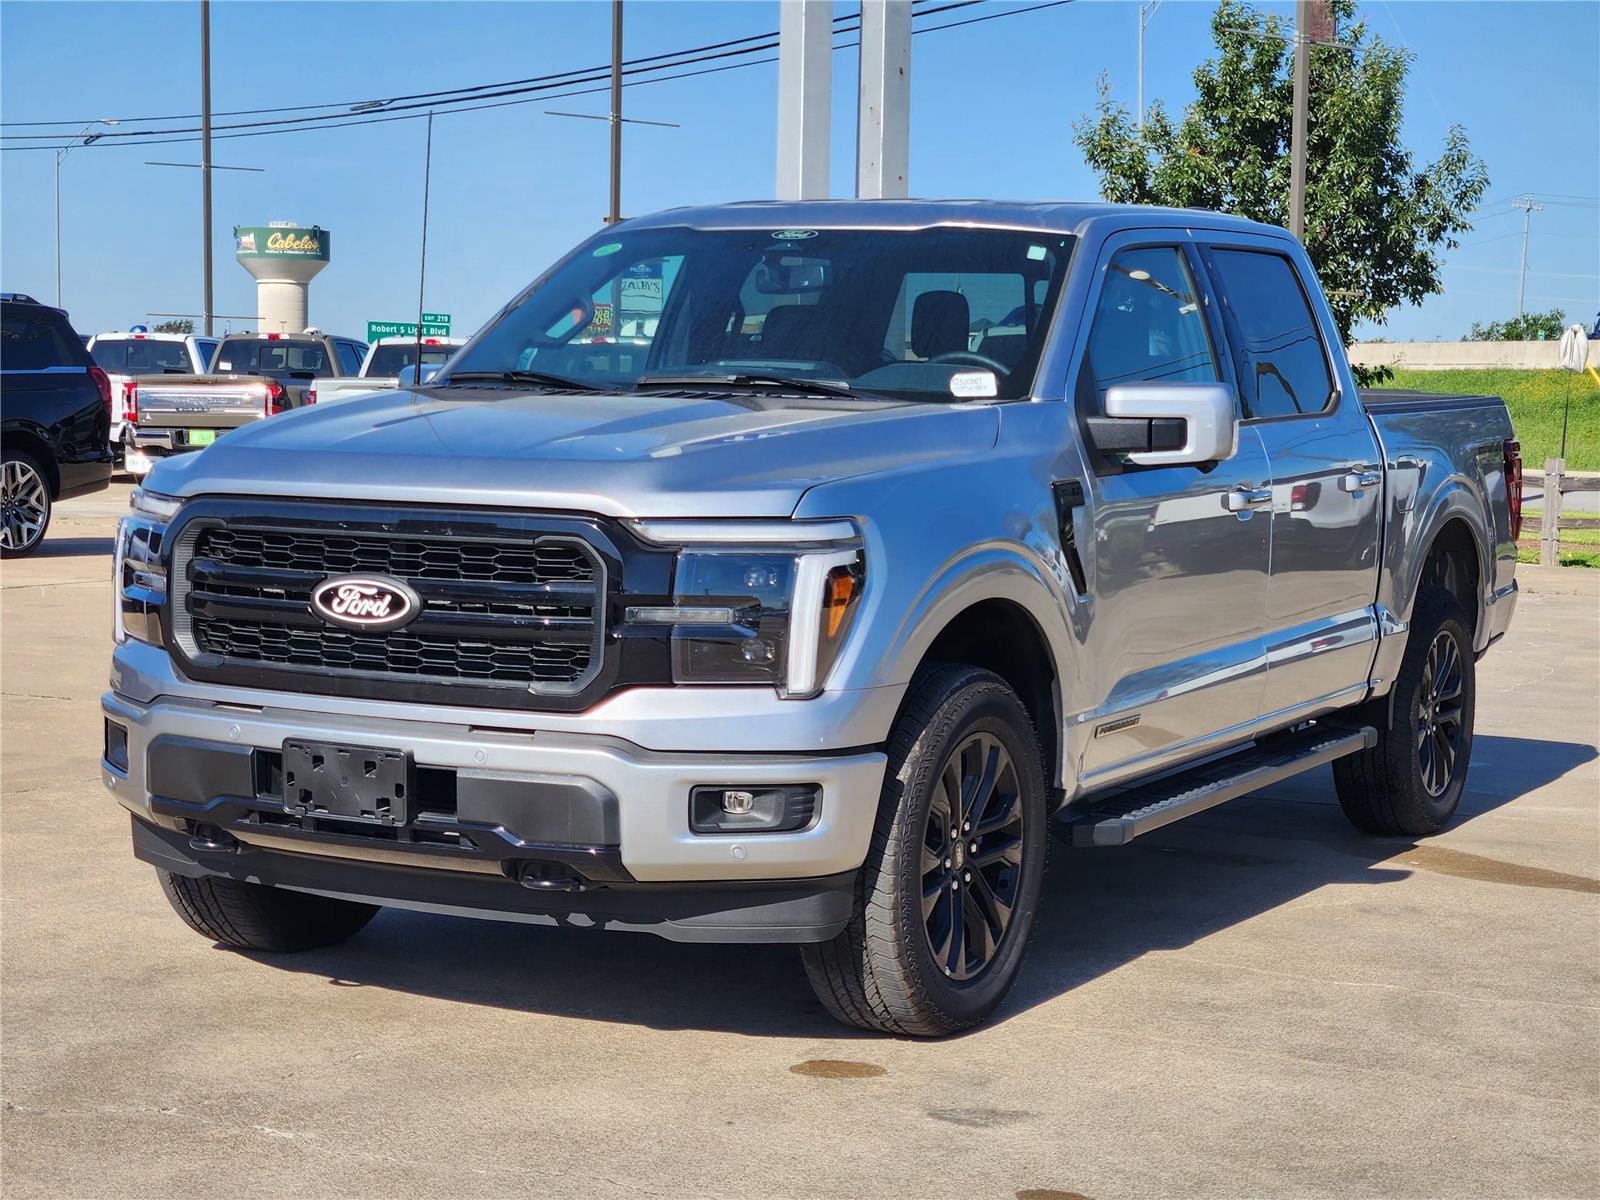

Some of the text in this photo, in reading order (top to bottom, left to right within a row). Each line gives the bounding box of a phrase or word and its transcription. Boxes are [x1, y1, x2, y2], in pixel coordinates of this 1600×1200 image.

[267, 232, 320, 250] Cabela's
[371, 324, 447, 336] Robert S Ligt Blvd
[331, 585, 392, 617] Ford
